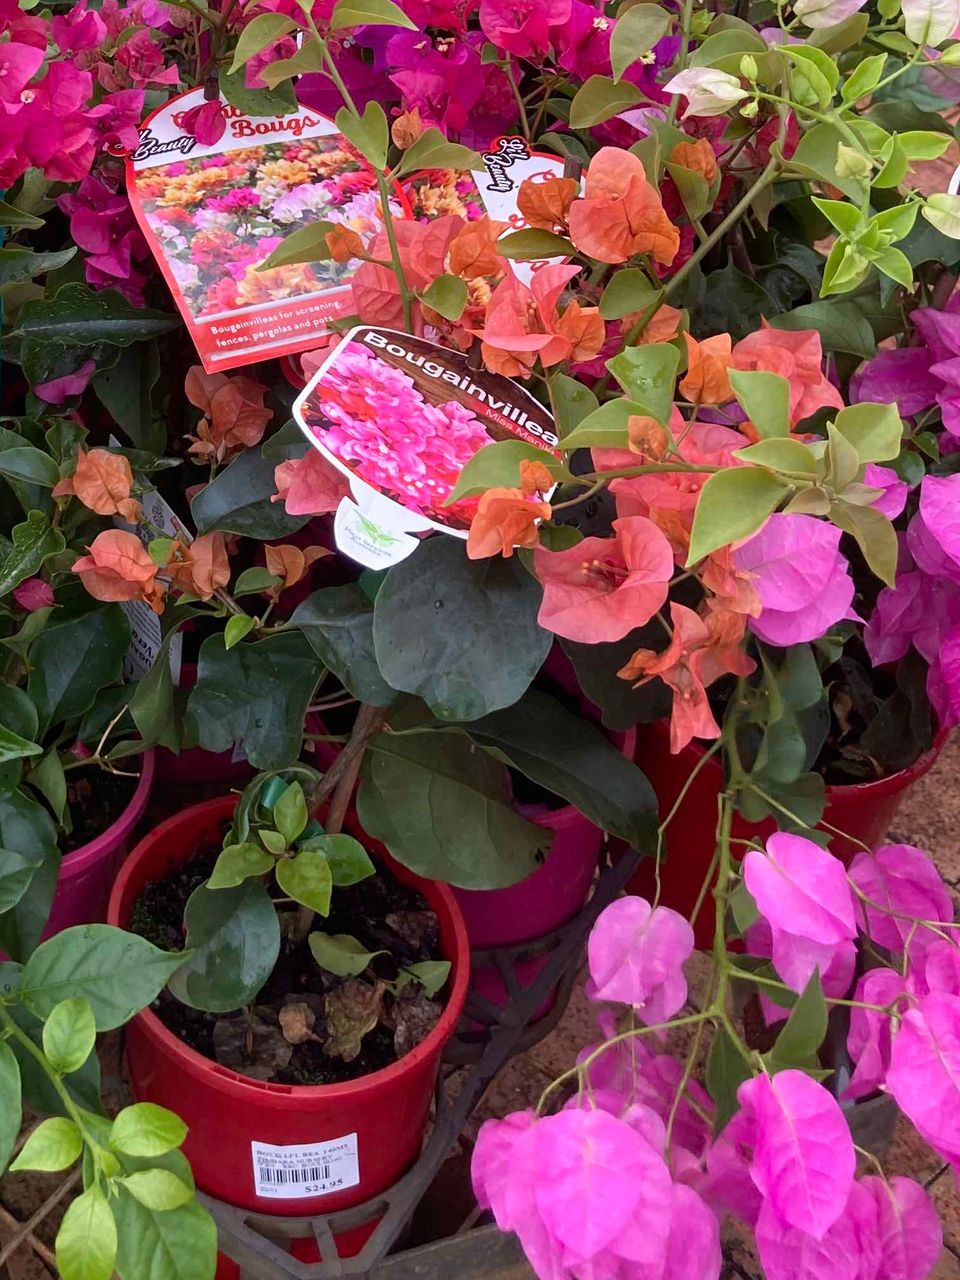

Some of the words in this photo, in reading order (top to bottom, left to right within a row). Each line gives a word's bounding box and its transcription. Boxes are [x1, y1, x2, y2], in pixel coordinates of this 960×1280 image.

[231, 114, 321, 138] Bougs
[131, 136, 196, 161] Beauty
[482, 153, 514, 191] Beauty
[210, 314, 279, 335] Bougainvilleas
[279, 311, 293, 321] for
[252, 326, 293, 342] pergolas
[294, 318, 311, 330] and
[363, 331, 560, 447] Bougainvillea
[485, 408, 514, 431] Miss
[304, 1178, 344, 1193] $24.95
